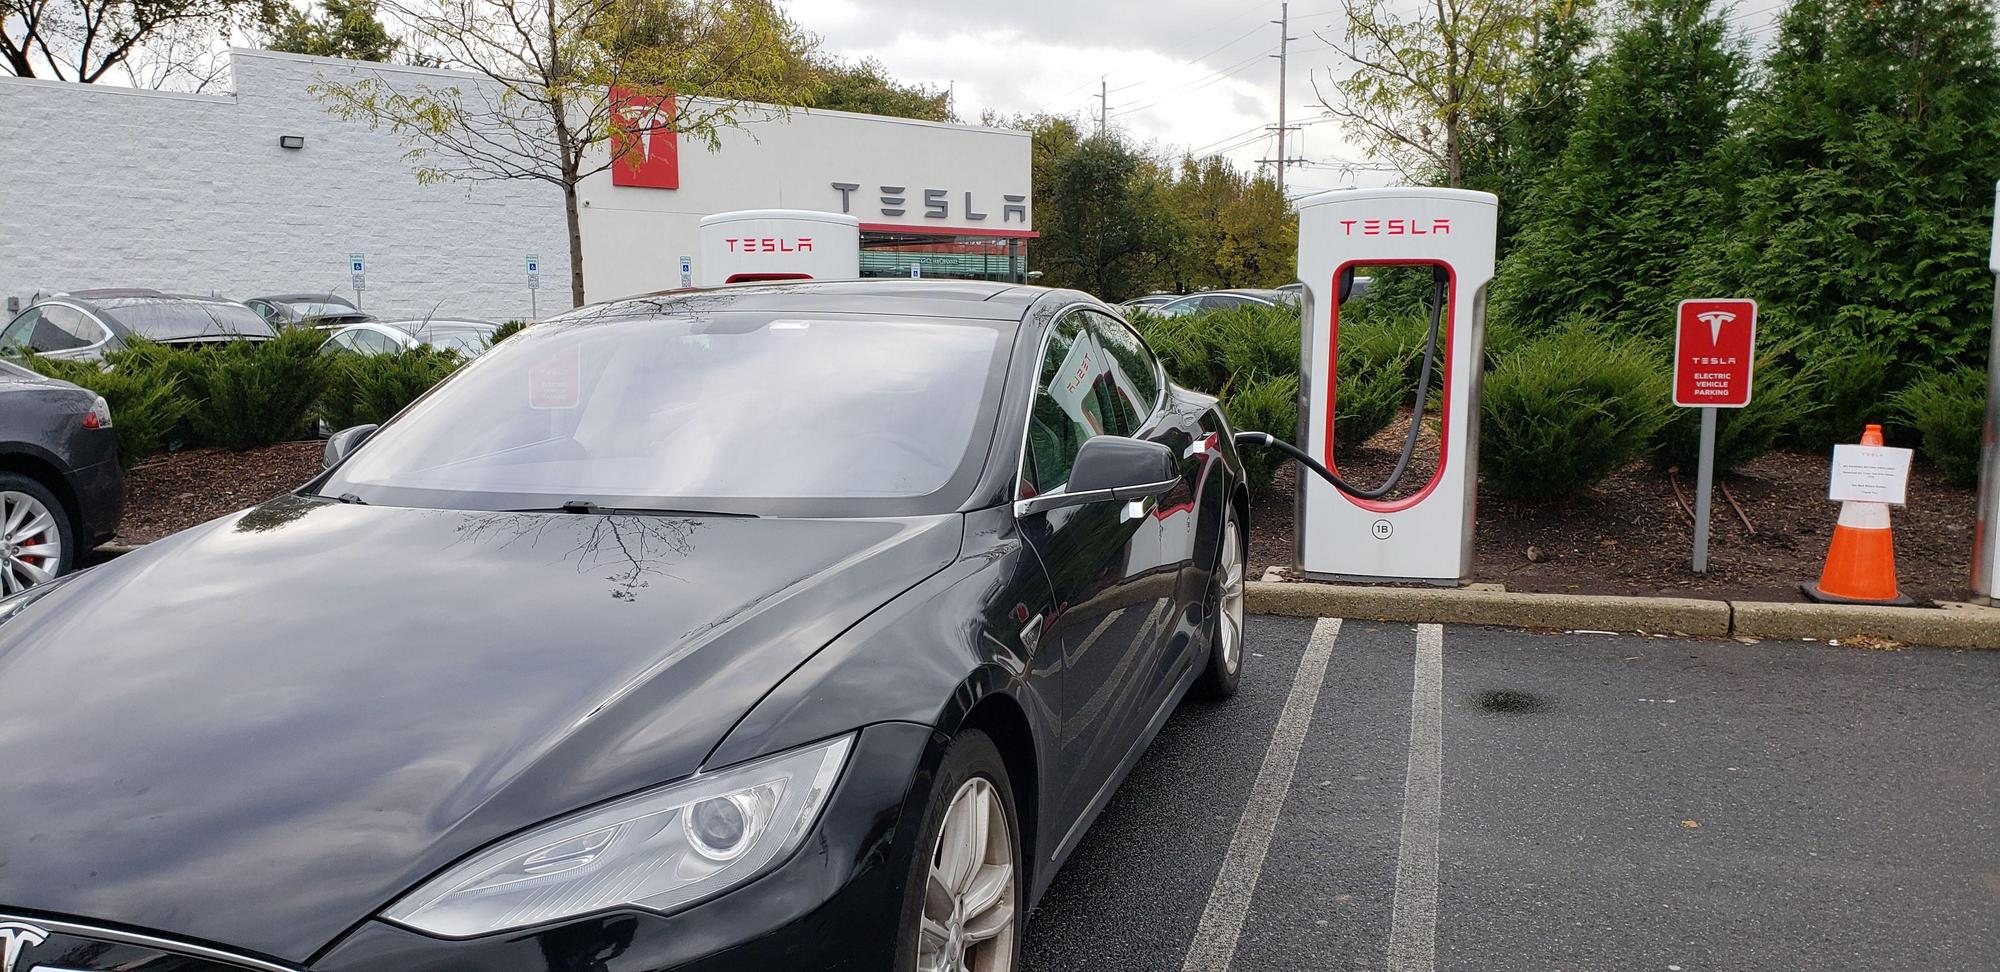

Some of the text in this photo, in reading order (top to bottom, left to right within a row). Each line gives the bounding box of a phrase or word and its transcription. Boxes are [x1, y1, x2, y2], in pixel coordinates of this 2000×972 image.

[831, 182, 1026, 223] TESLA
[1339, 218, 1451, 236] TESLA
[725, 238, 812, 253] TESLA
[1691, 356, 1737, 365] TESLA
[1694, 372, 1732, 380] ELECTRIC
[1695, 380, 1729, 388] VEHICLE
[1694, 388, 1729, 396] PARKING
[1376, 525, 1389, 534] 1B
